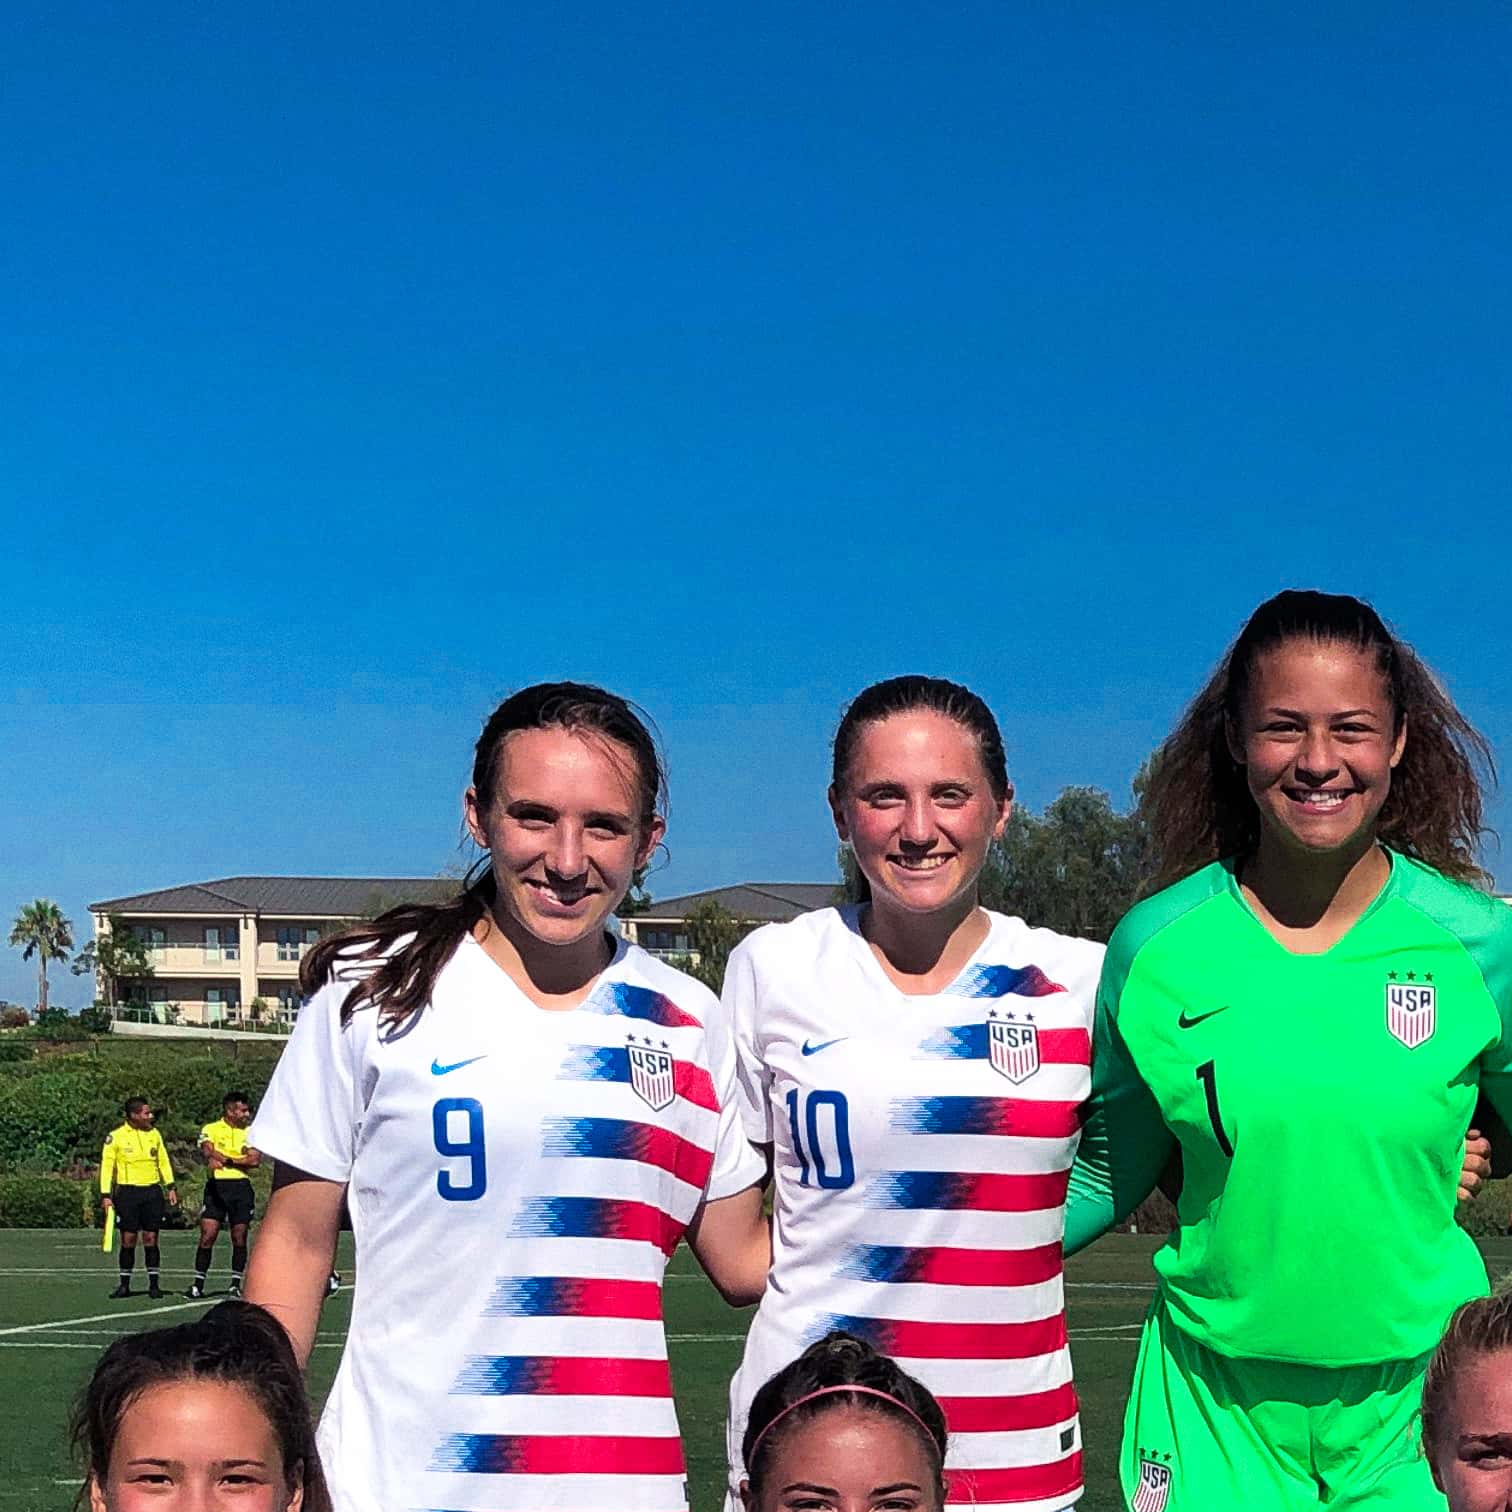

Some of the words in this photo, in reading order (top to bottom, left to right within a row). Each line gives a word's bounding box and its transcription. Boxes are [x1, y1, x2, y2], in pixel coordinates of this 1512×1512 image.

[1392, 989, 1431, 1011] USA
[992, 1026, 1033, 1047] USA
[632, 1051, 669, 1075] USA
[1195, 1058, 1235, 1158] 1
[432, 1097, 487, 1201] 9
[786, 1087, 855, 1189] 10
[1143, 1463, 1168, 1488] USA
